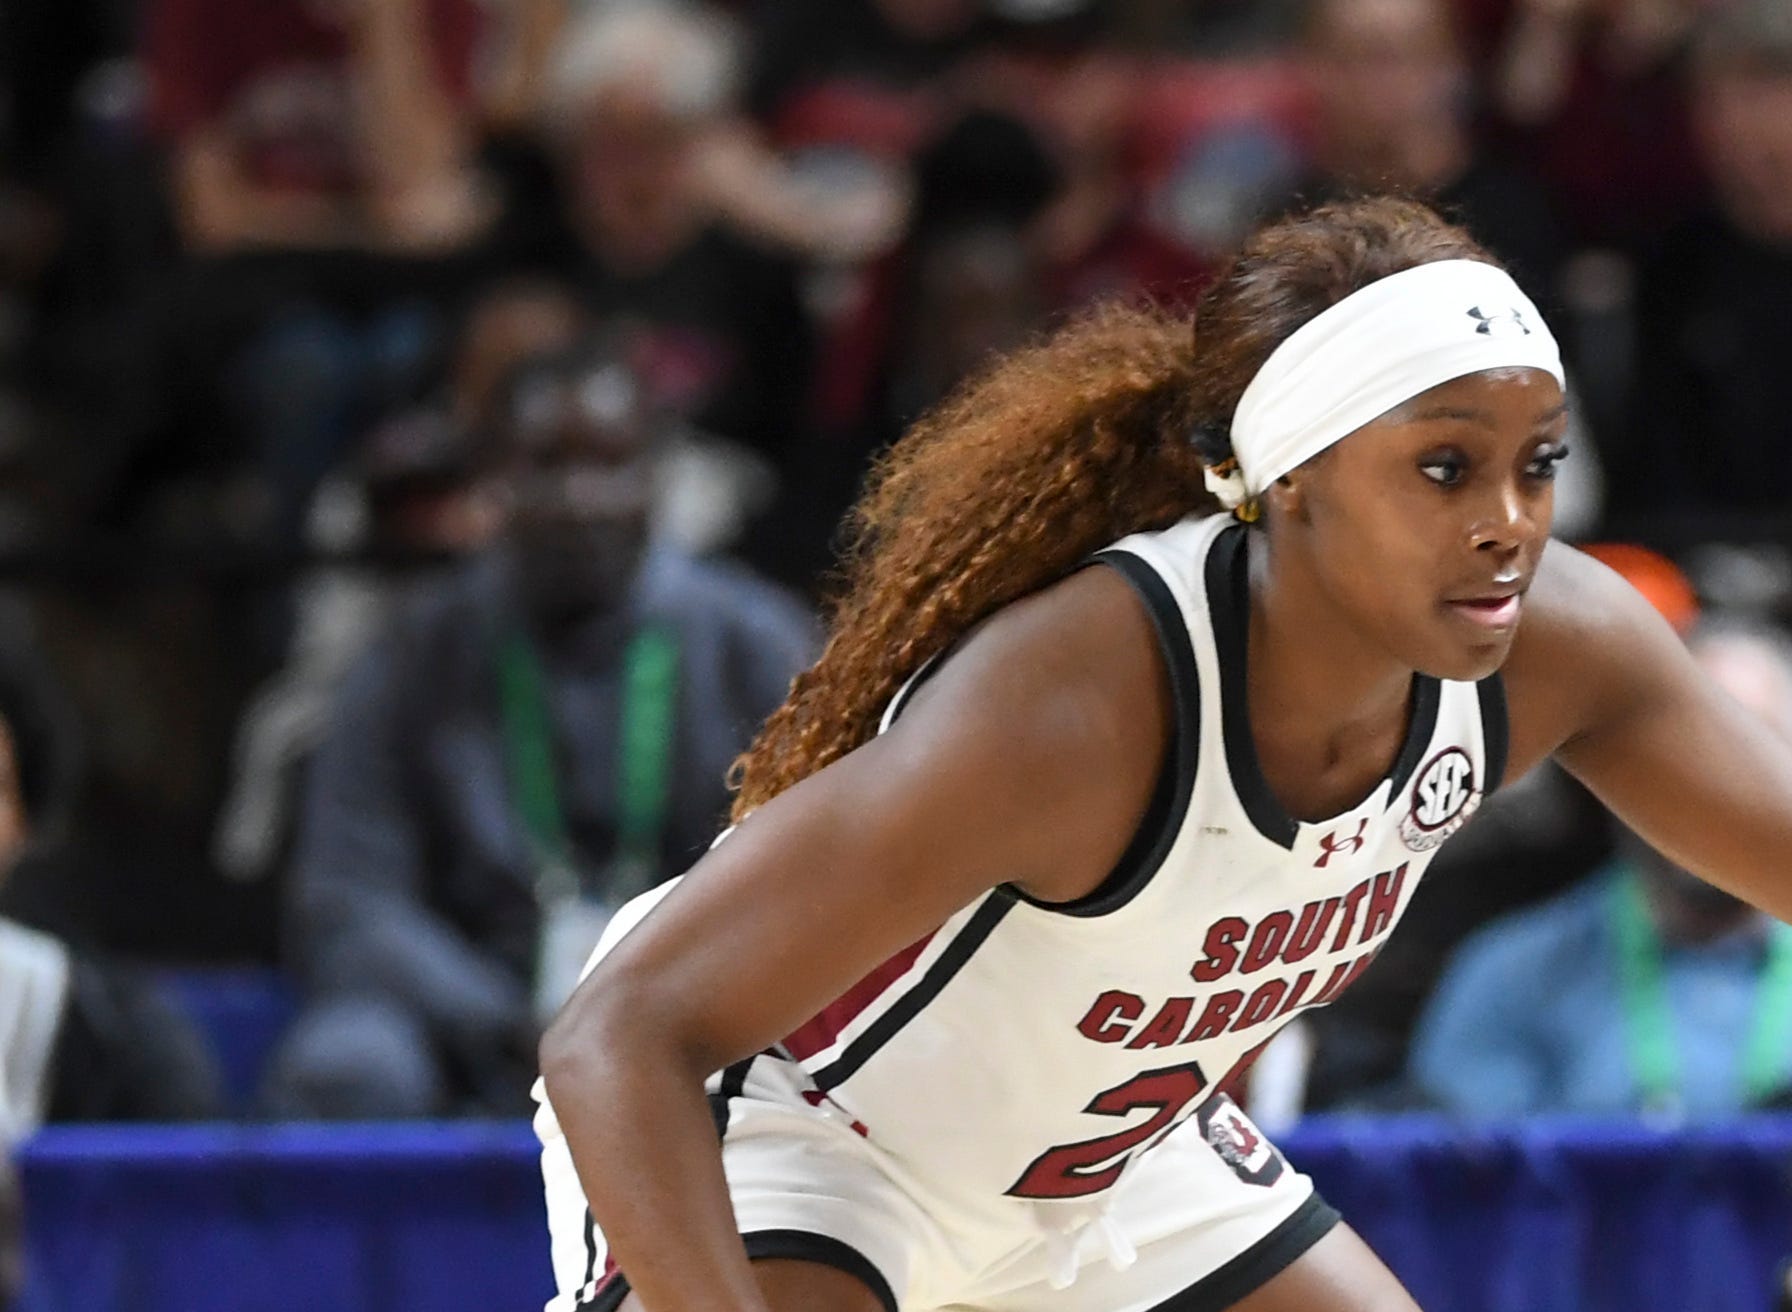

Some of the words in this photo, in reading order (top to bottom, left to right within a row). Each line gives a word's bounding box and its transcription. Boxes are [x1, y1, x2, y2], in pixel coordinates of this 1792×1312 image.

[1415, 750, 1472, 826] SEC
[1190, 861, 1409, 982] SOUTH
[1002, 1038, 1270, 1199] 2
